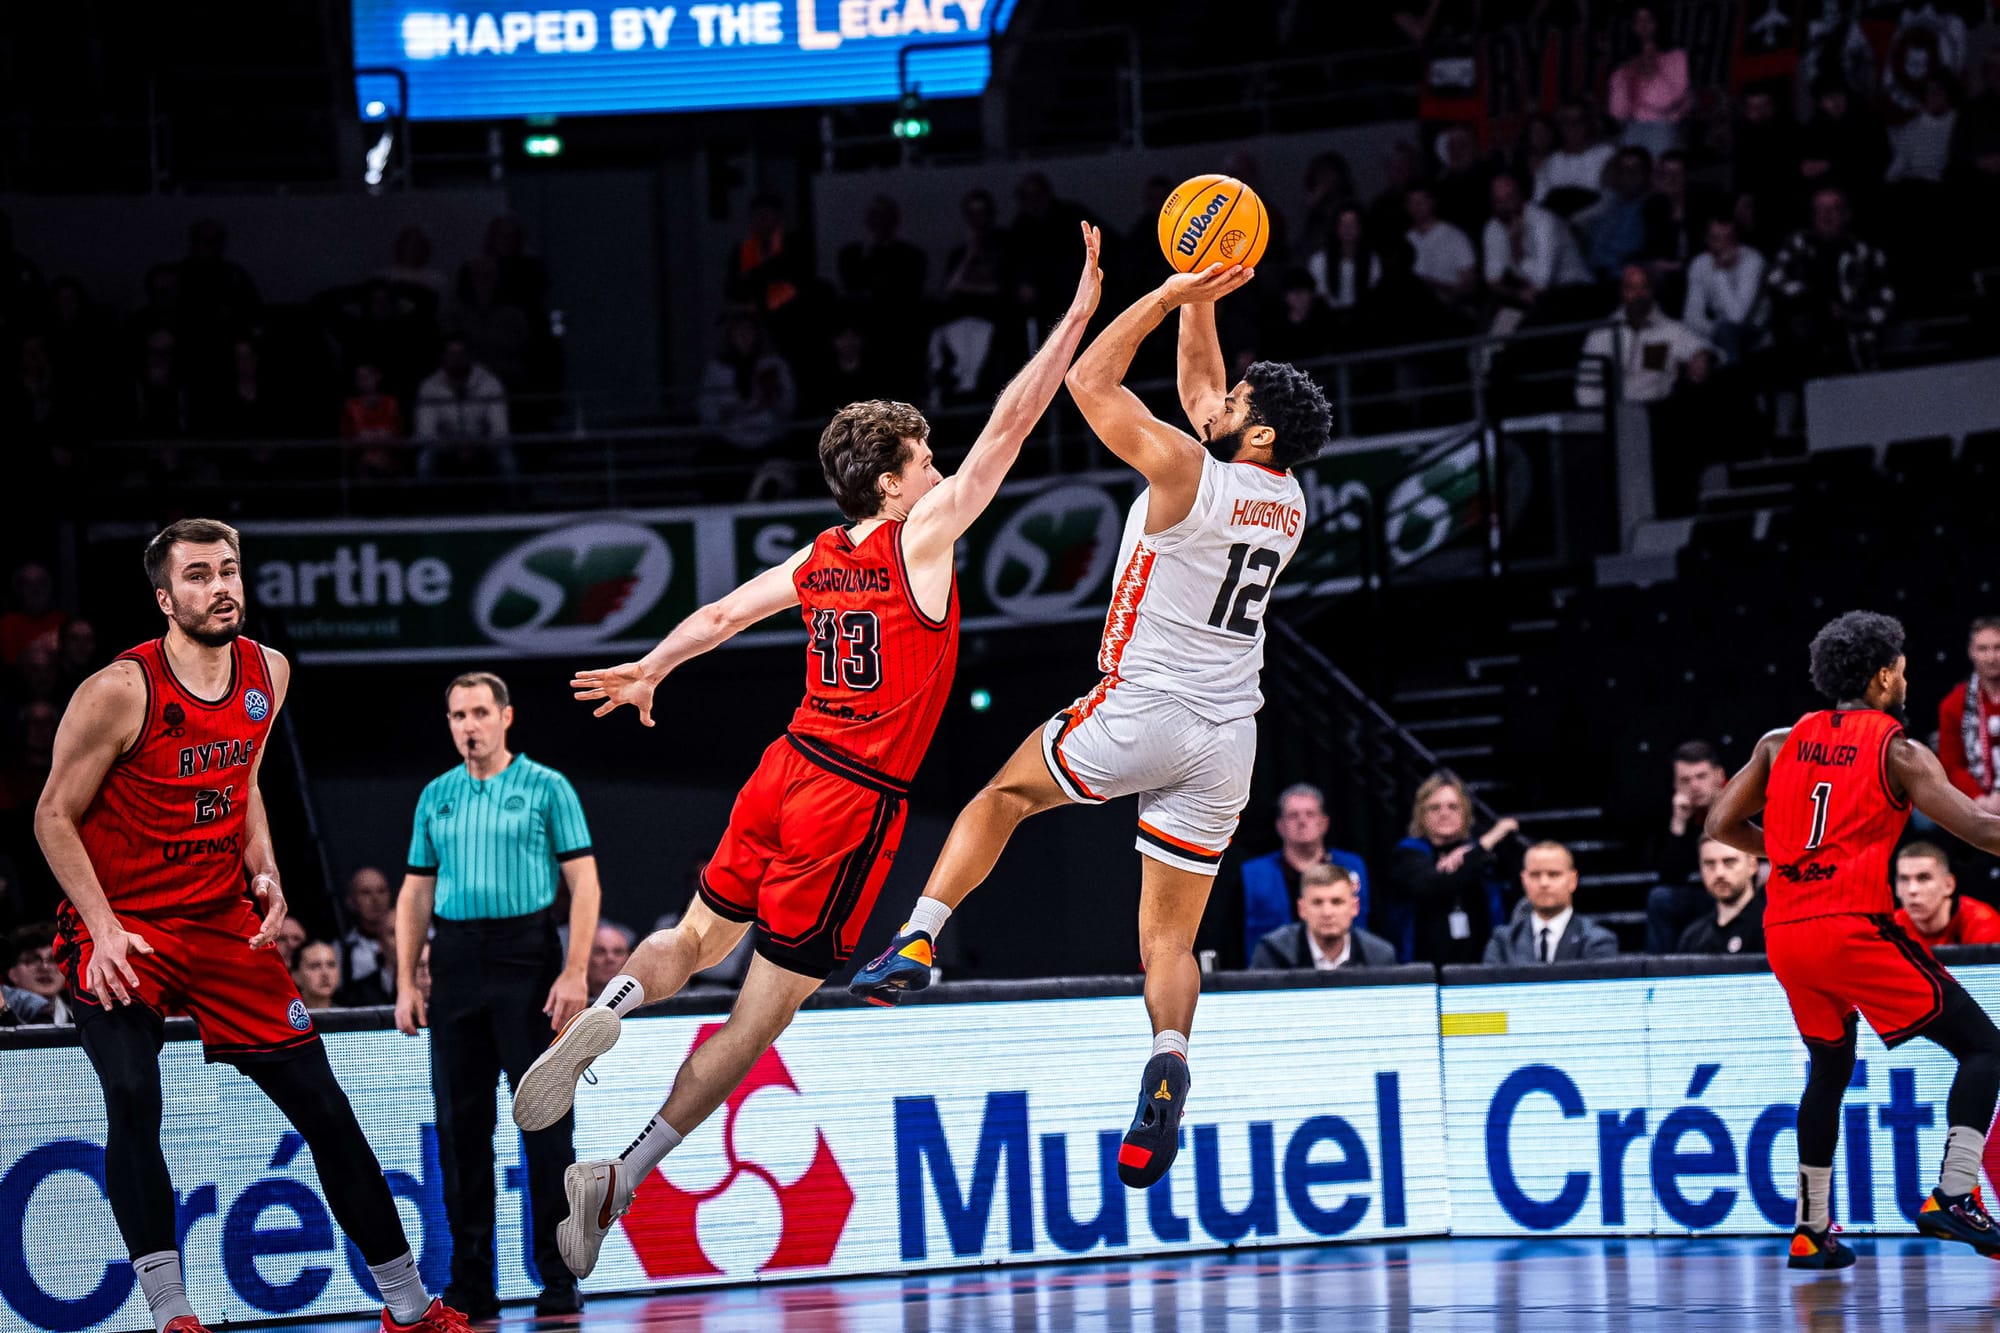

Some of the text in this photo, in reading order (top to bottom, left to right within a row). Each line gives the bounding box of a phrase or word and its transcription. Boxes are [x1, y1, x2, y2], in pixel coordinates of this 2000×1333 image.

[401, 0, 985, 58] SHAPED BY THE LEGACY
[1177, 194, 1229, 256] Wilson
[1231, 499, 1300, 538] HUDGINS
[255, 542, 453, 608] arthe
[1208, 543, 1280, 637] 12
[811, 608, 882, 692] 43
[1797, 740, 1858, 768] WALKER
[194, 785, 233, 824] 21
[1805, 782, 1832, 849] 1
[163, 832, 240, 861] UTENOS
[0, 1122, 545, 1332] Créd
